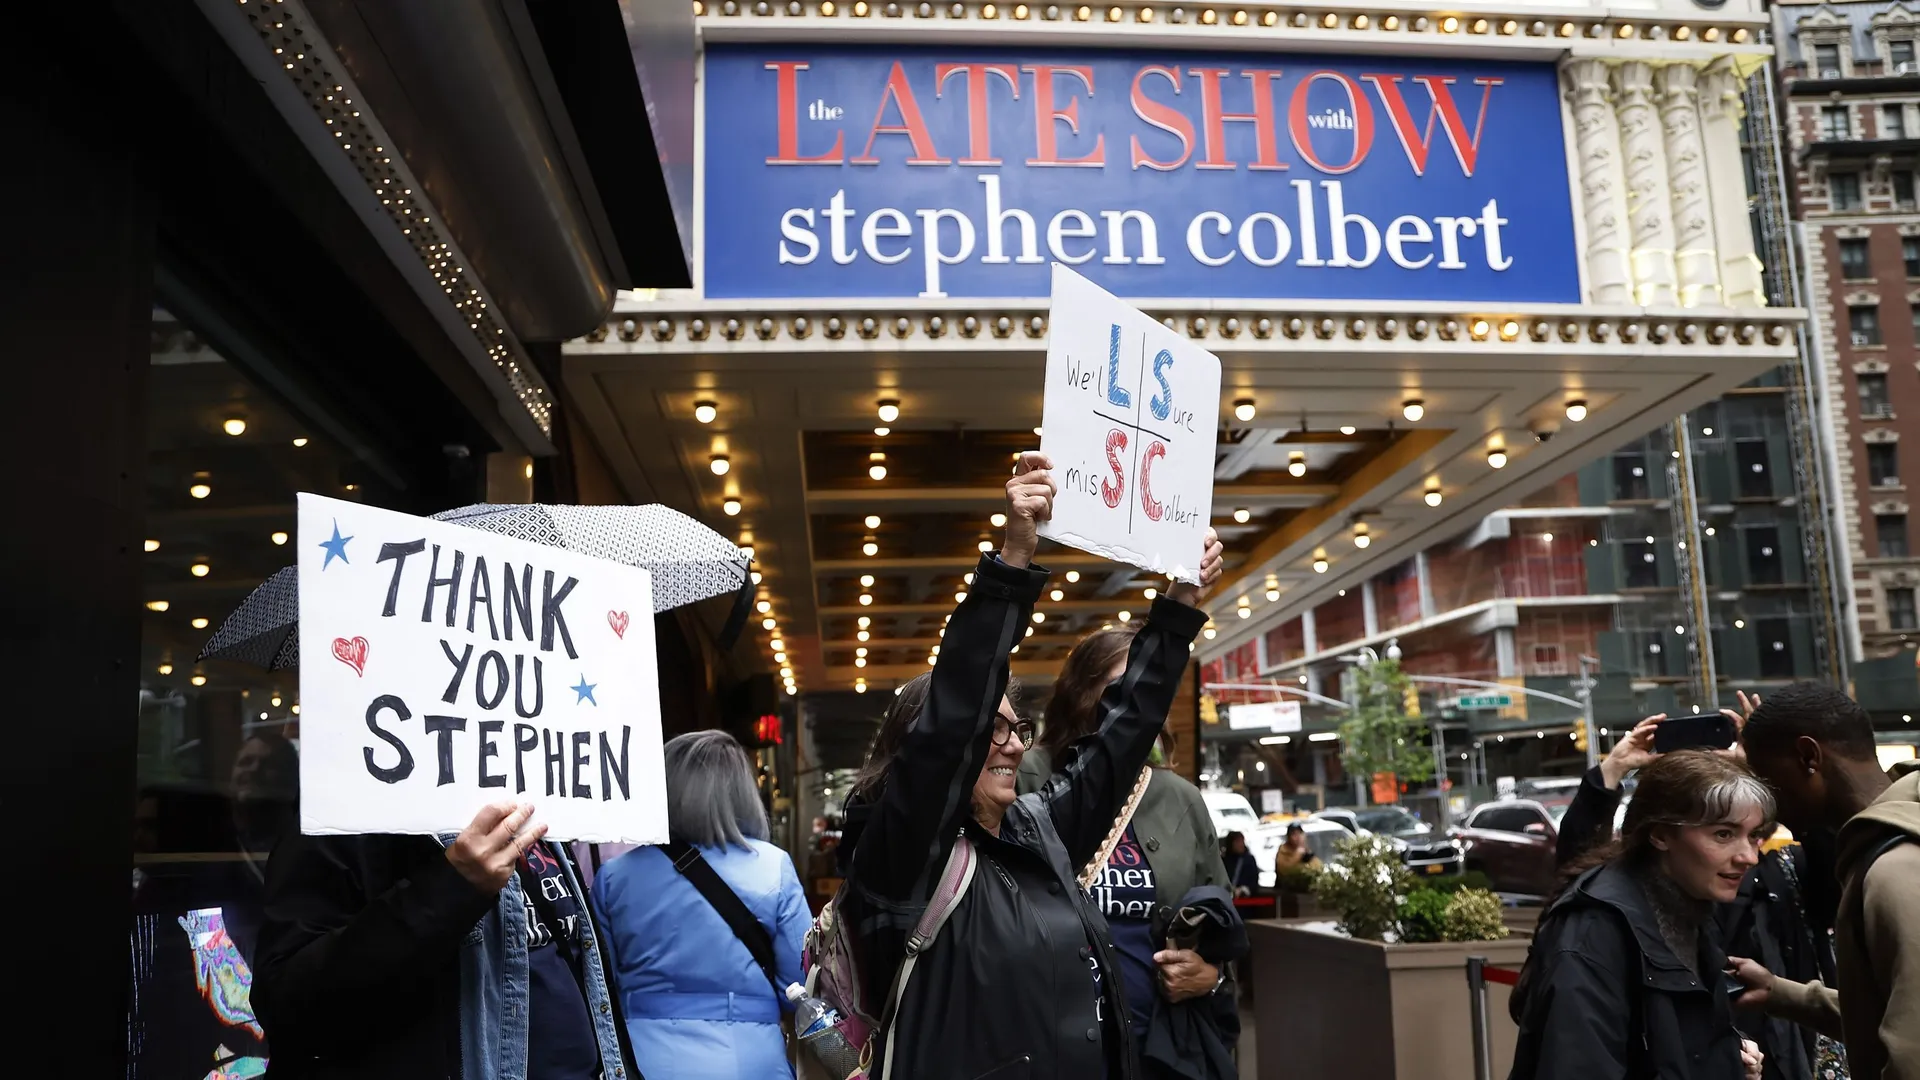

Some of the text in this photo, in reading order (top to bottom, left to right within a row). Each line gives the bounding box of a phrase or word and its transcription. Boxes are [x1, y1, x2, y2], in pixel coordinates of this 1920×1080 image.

[764, 60, 1505, 178] LATE SHOW
[808, 98, 844, 121] the
[1307, 108, 1354, 131] with
[779, 174, 1513, 298] stephen colbert
[1150, 349, 1195, 433] Sure
[1140, 440, 1199, 528] Colbert
[376, 538, 579, 660] THANK
[439, 638, 544, 719] YOU
[363, 694, 631, 802] STEPHEN
